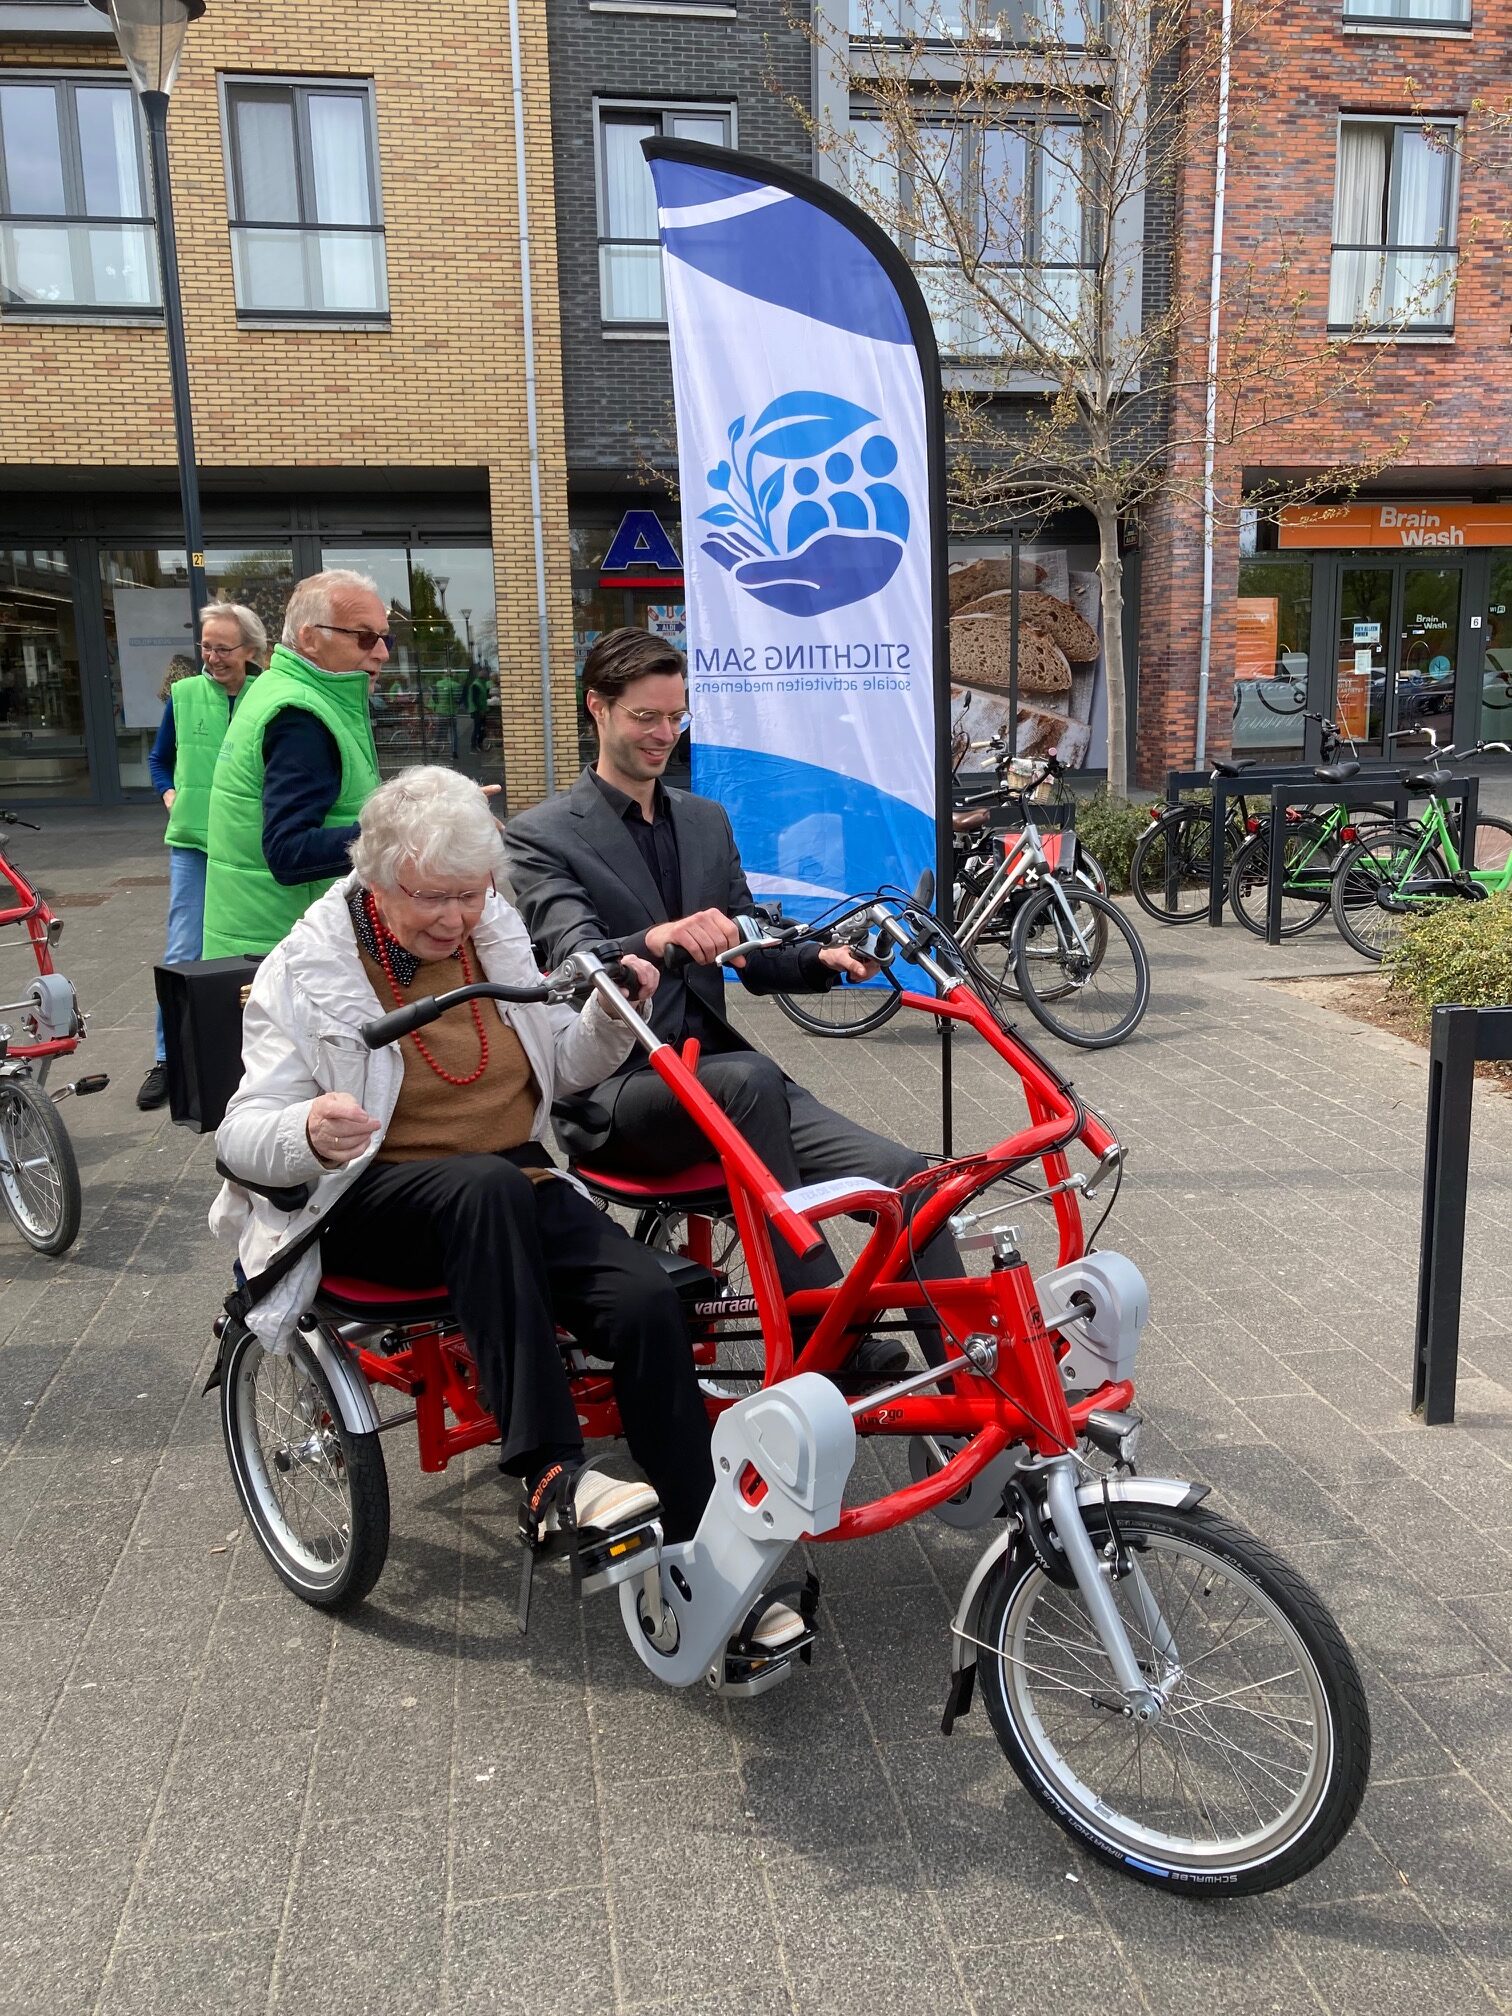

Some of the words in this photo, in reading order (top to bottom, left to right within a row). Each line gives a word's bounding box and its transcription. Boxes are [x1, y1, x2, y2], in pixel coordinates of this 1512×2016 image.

[1380, 506, 1440, 527] Brain
[1401, 525, 1464, 546] Wash
[194, 554, 204, 566] 27
[1416, 614, 1439, 623] Brain
[1423, 620, 1448, 630] Wash
[1473, 618, 1479, 627] 6
[530, 1464, 563, 1513] vanraam
[1042, 1790, 1066, 1816] PLUS
[1068, 1817, 1124, 1859] MARATHON
[1171, 1872, 1238, 1883] SCHWALBE
